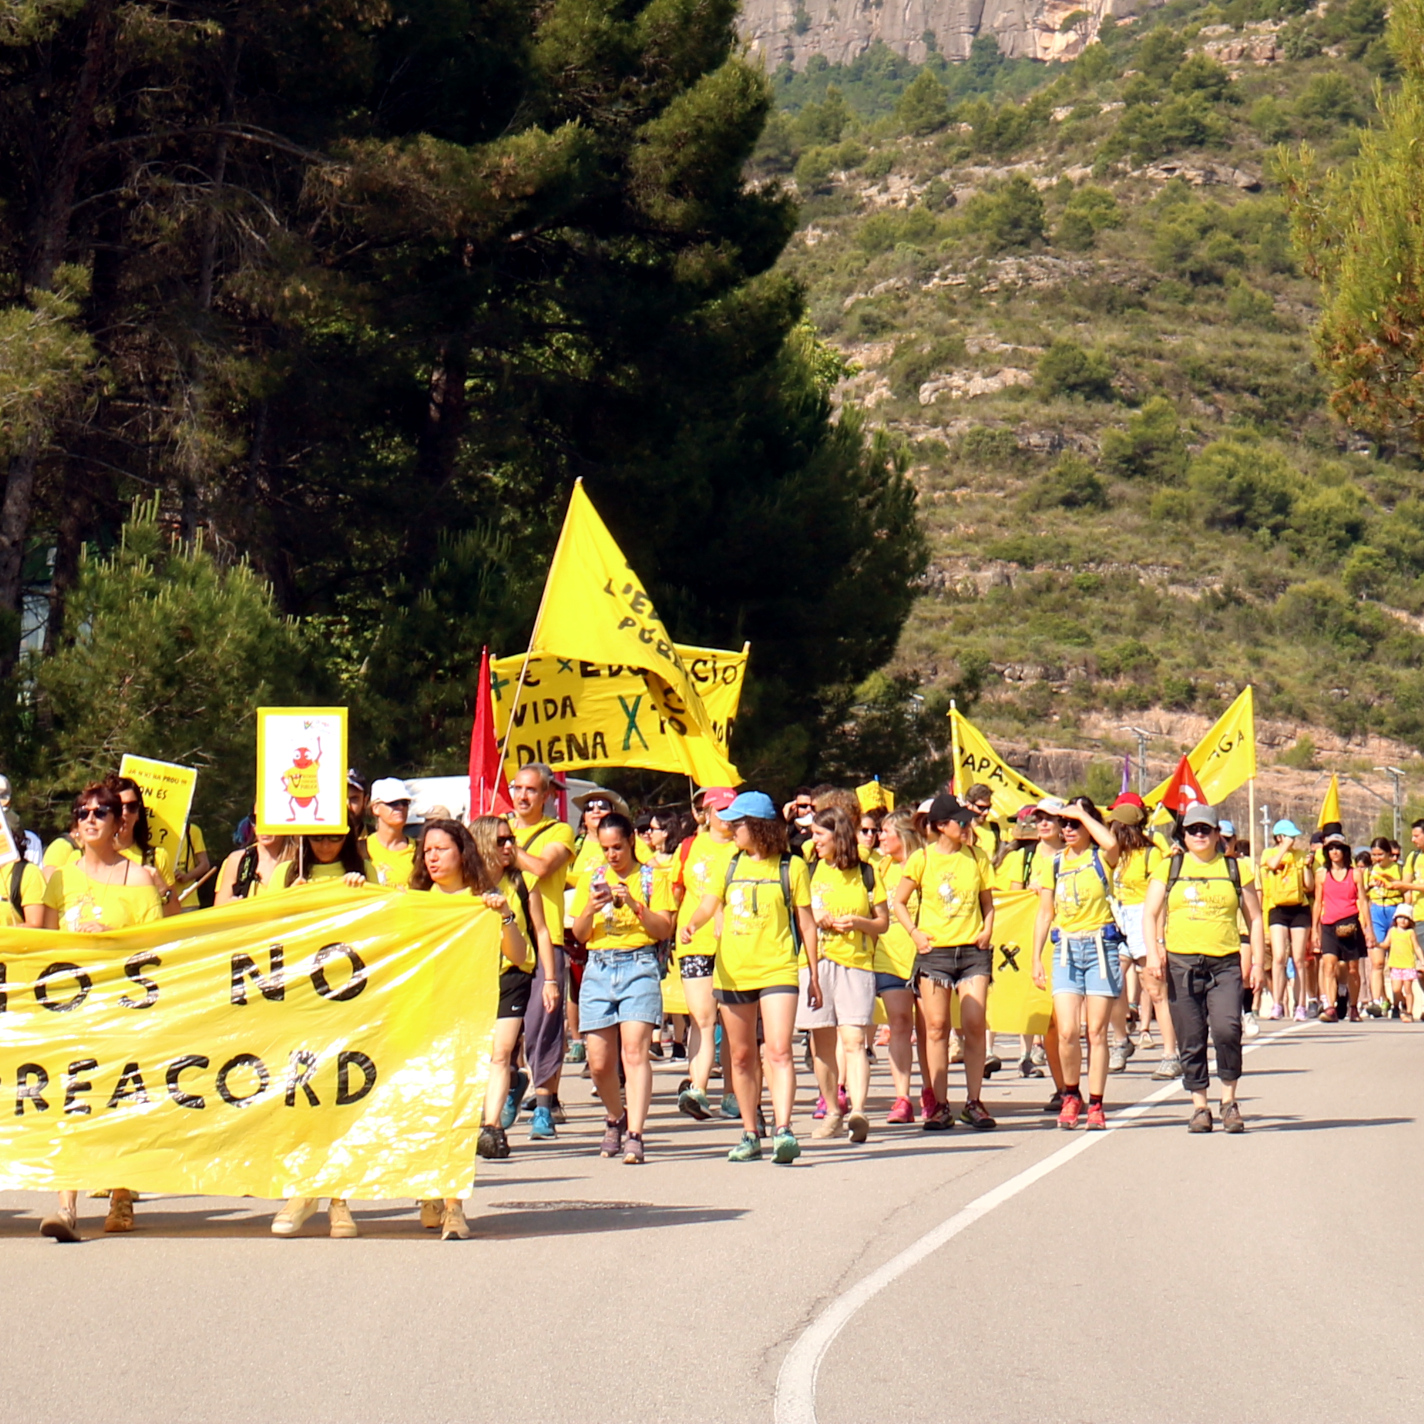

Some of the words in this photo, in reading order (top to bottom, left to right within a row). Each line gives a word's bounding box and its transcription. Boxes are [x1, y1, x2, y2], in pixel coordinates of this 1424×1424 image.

[509, 695, 577, 728] VIDA
[516, 731, 609, 769] DIGNA
[163, 776, 179, 784] PROU
[230, 942, 368, 1006] NO
